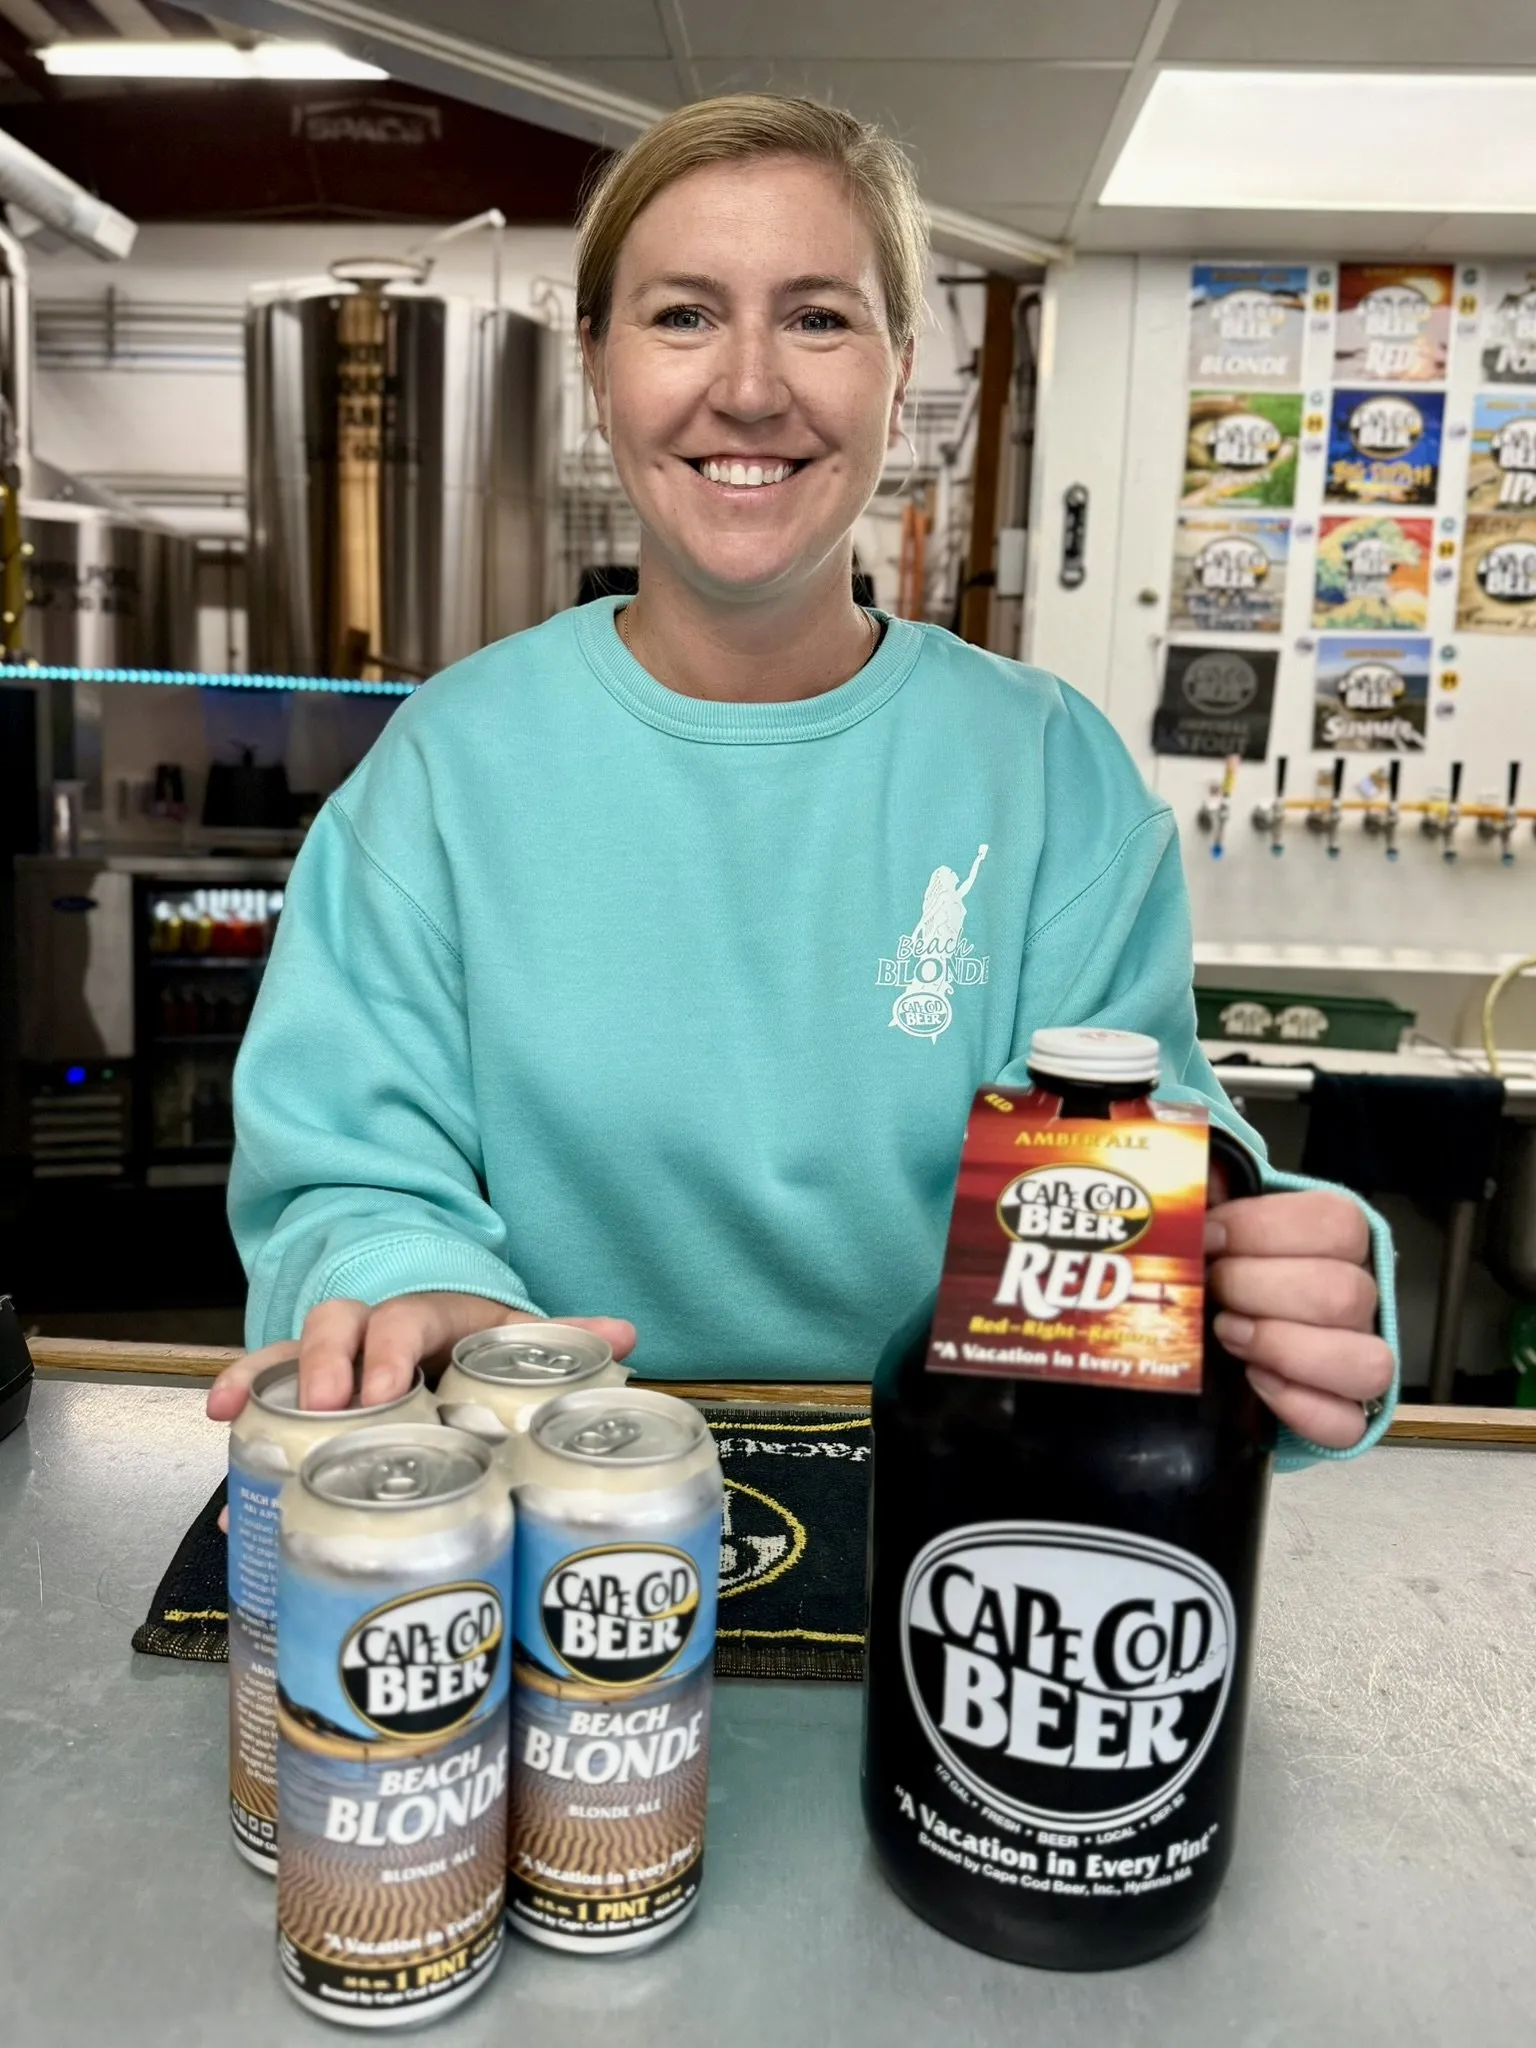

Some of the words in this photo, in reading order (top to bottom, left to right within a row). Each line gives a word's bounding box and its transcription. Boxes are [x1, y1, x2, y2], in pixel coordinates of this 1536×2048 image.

[897, 927, 975, 960] Beach
[905, 1012, 942, 1026] BEER
[1015, 1131, 1100, 1148] AMBER
[1104, 1134, 1149, 1150] ALE
[1015, 1180, 1077, 1209] CAPE
[1084, 1183, 1138, 1213] COD
[1017, 1204, 1128, 1242] BEER
[994, 1240, 1134, 1320] RED
[962, 1343, 1047, 1365] Vacation
[1052, 1349, 1074, 1369] in
[1078, 1352, 1133, 1376] Every
[556, 1571, 630, 1617] CAPE
[636, 1567, 690, 1618] COD
[358, 1622, 441, 1667] CAPE
[446, 1601, 496, 1661] COD
[562, 1608, 682, 1660] BEER
[929, 1562, 1087, 1684] CAPE
[1093, 1597, 1213, 1691] COD
[366, 1654, 490, 1716] BEER
[939, 1642, 1189, 1769] BEER
[568, 1704, 670, 1737] BEACH
[523, 1710, 703, 1785] BLONDE
[378, 1744, 482, 1797] BEACH
[568, 1804, 631, 1819] BLONDE
[635, 1798, 661, 1816] ALE
[980, 1806, 1021, 1834] FRESH
[1037, 1831, 1079, 1849] BEER
[1095, 1826, 1137, 1845] LOCAL
[919, 1803, 1039, 1871] Vacation
[1047, 1850, 1077, 1877] in
[1085, 1854, 1161, 1880] Every
[380, 1858, 447, 1884] BLONDE
[452, 1843, 477, 1867] ALE
[534, 1859, 603, 1885] Vacation
[606, 1872, 624, 1885] in
[627, 1862, 668, 1883] Every
[918, 1831, 963, 1864] Brewed
[963, 1856, 980, 1875] by
[982, 1863, 1019, 1885] Cape
[1020, 1874, 1051, 1892] Cod
[1052, 1879, 1091, 1896] Beer,
[1123, 1874, 1172, 1895] Hyannis
[1173, 1865, 1194, 1883] MA
[577, 1902, 588, 1921] 1
[597, 1897, 650, 1921] PINT
[396, 1971, 407, 1991] 1
[417, 1949, 469, 1986] PINT
